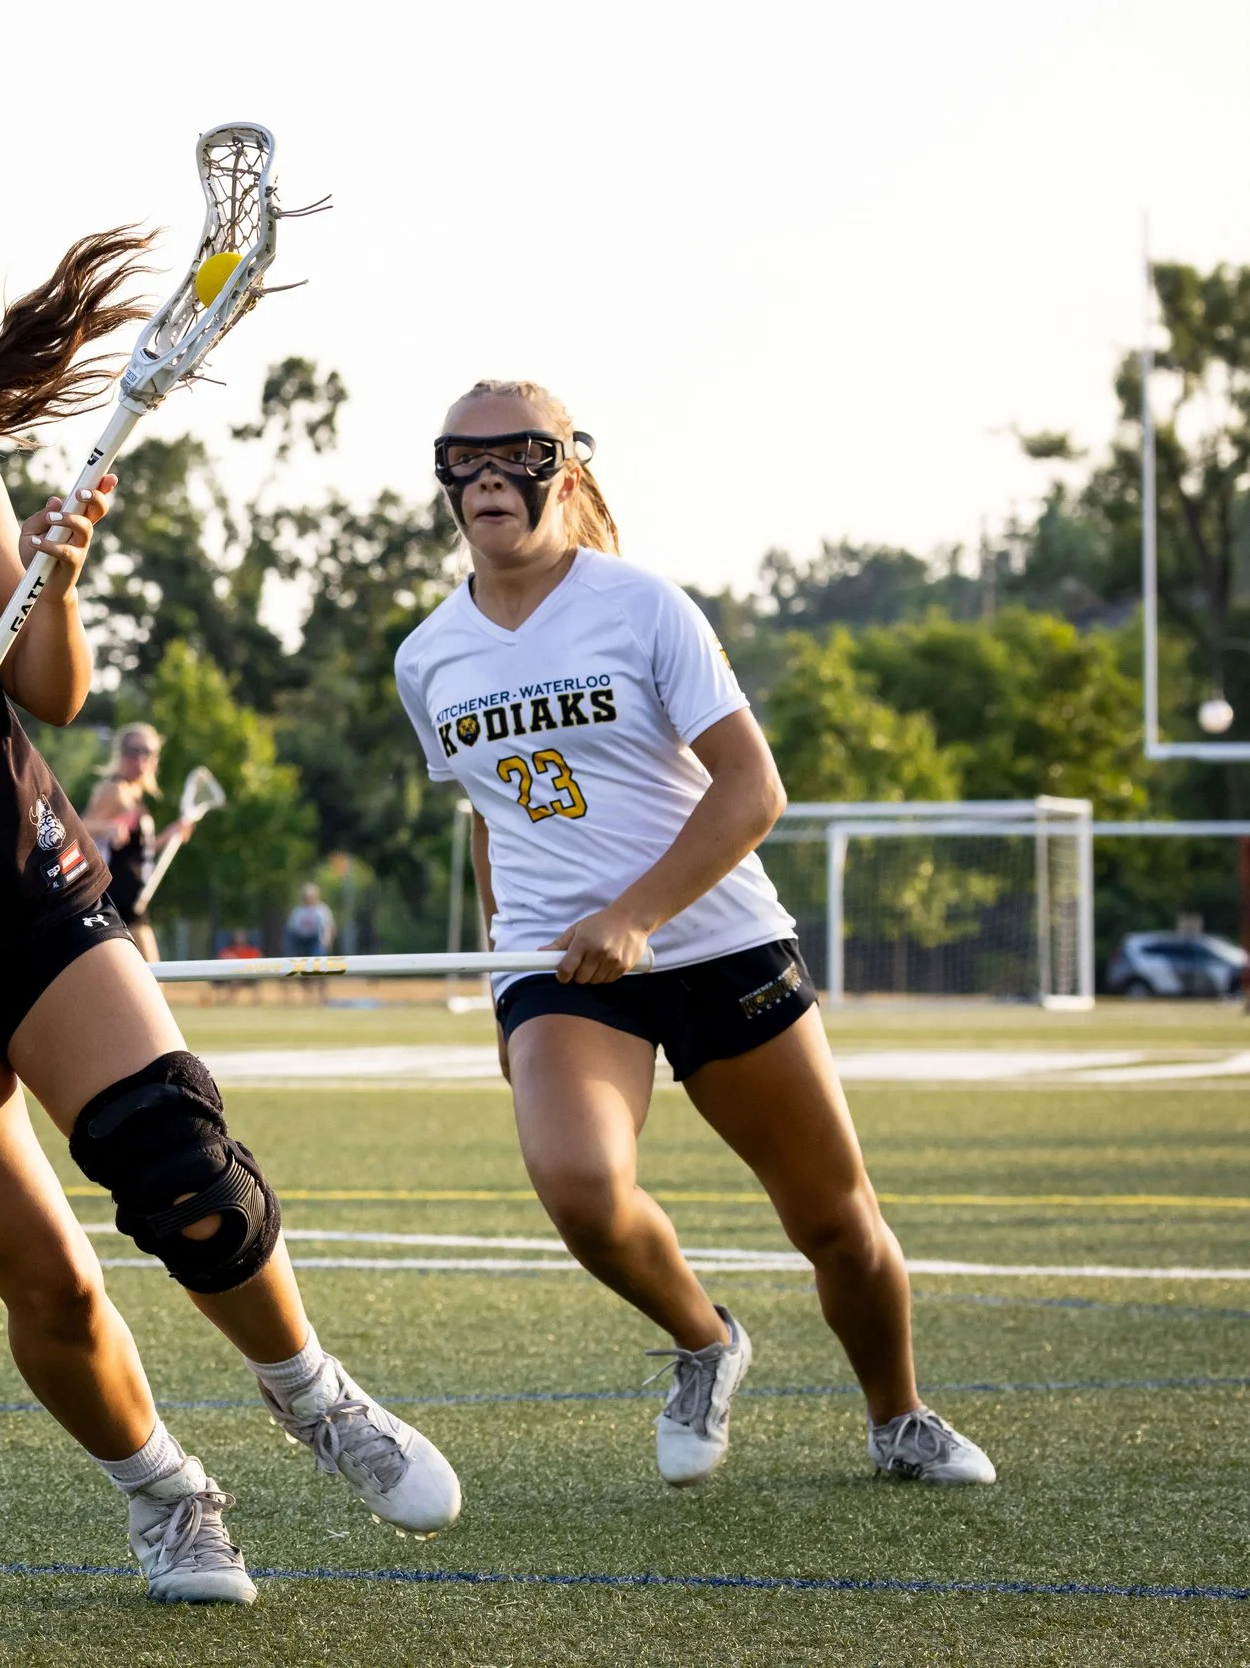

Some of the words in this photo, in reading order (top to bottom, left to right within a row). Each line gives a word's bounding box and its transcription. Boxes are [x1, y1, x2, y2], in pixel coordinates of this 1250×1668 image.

[436, 691, 510, 723] KITCHENER
[519, 674, 611, 698] WATERLOO
[497, 748, 588, 823] 23
